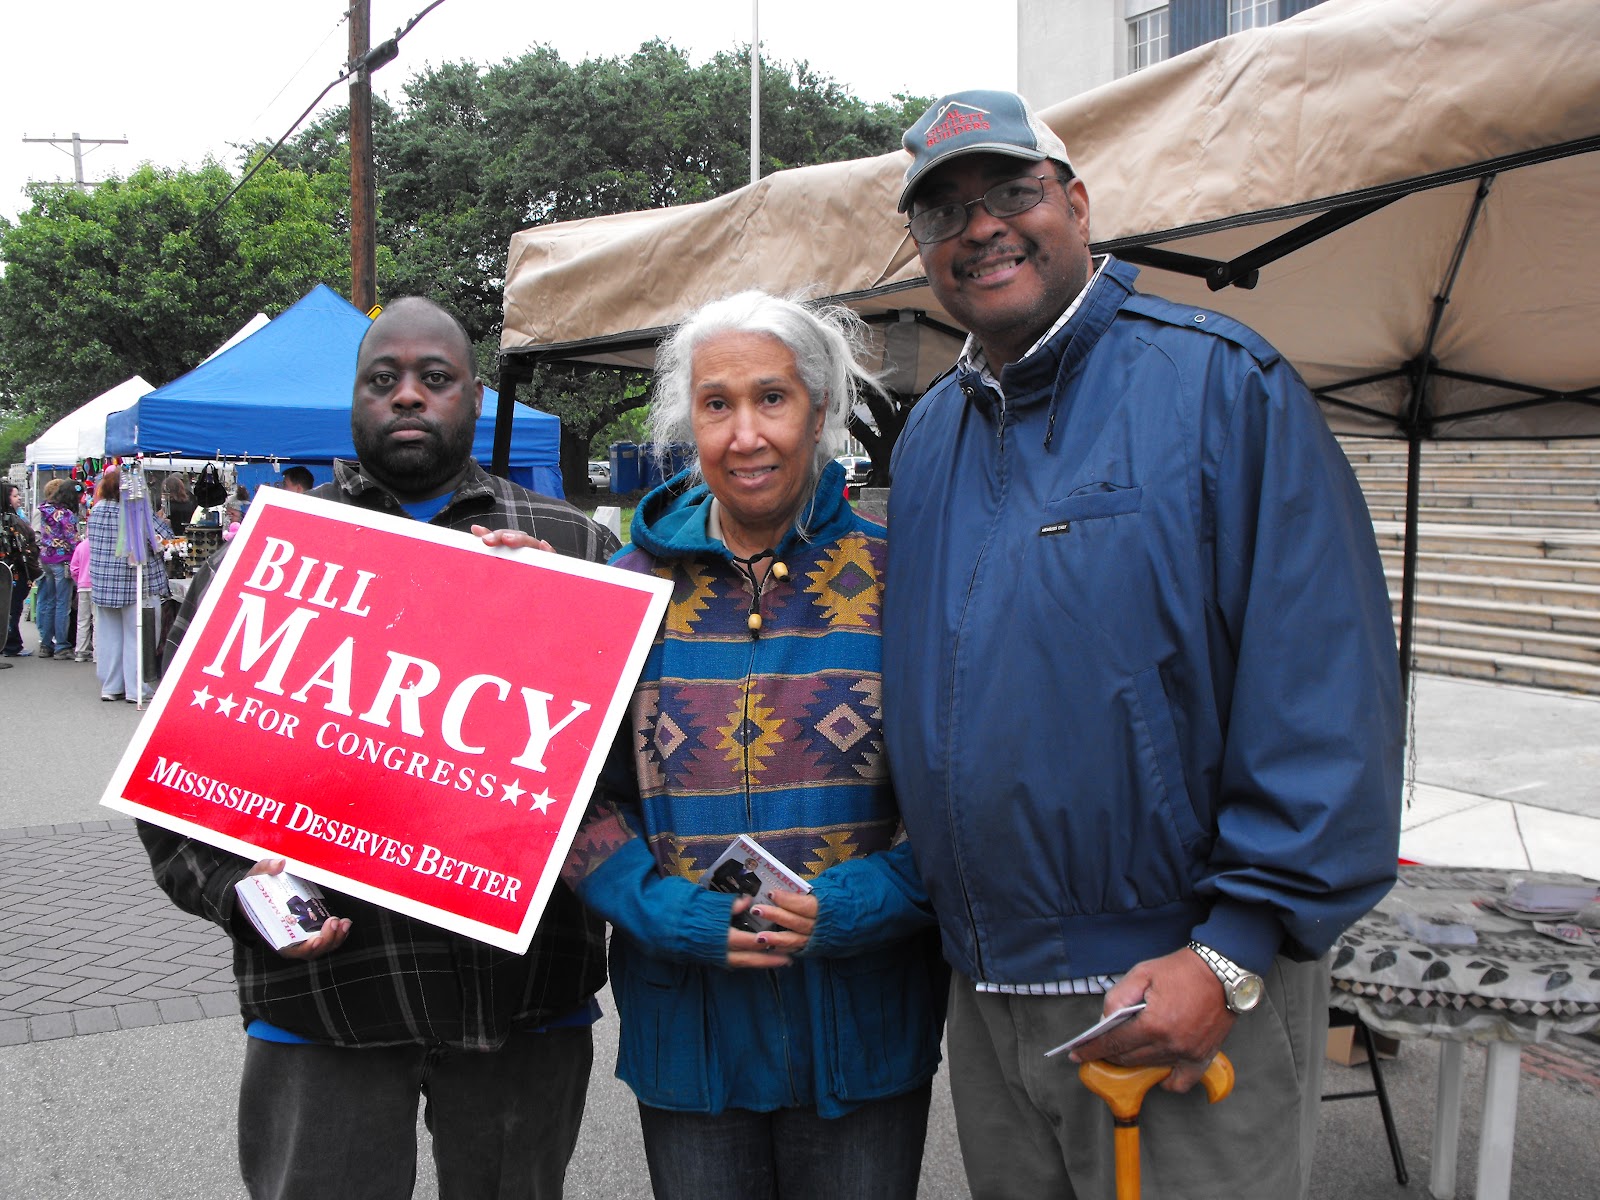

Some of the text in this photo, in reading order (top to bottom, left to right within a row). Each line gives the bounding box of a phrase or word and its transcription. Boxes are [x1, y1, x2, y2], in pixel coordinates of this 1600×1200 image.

[927, 122, 990, 147] BUILDERS
[946, 109, 961, 120] AL
[243, 536, 377, 618] BILL
[201, 591, 592, 774] MARCY
[235, 696, 497, 798] FOR CONGRESS
[147, 756, 522, 903] MISSISSIPPI DESERVES BETTER
[740, 842, 805, 894] BILL MARCY
[252, 877, 281, 915] MARCY
[281, 917, 297, 939] BILL
